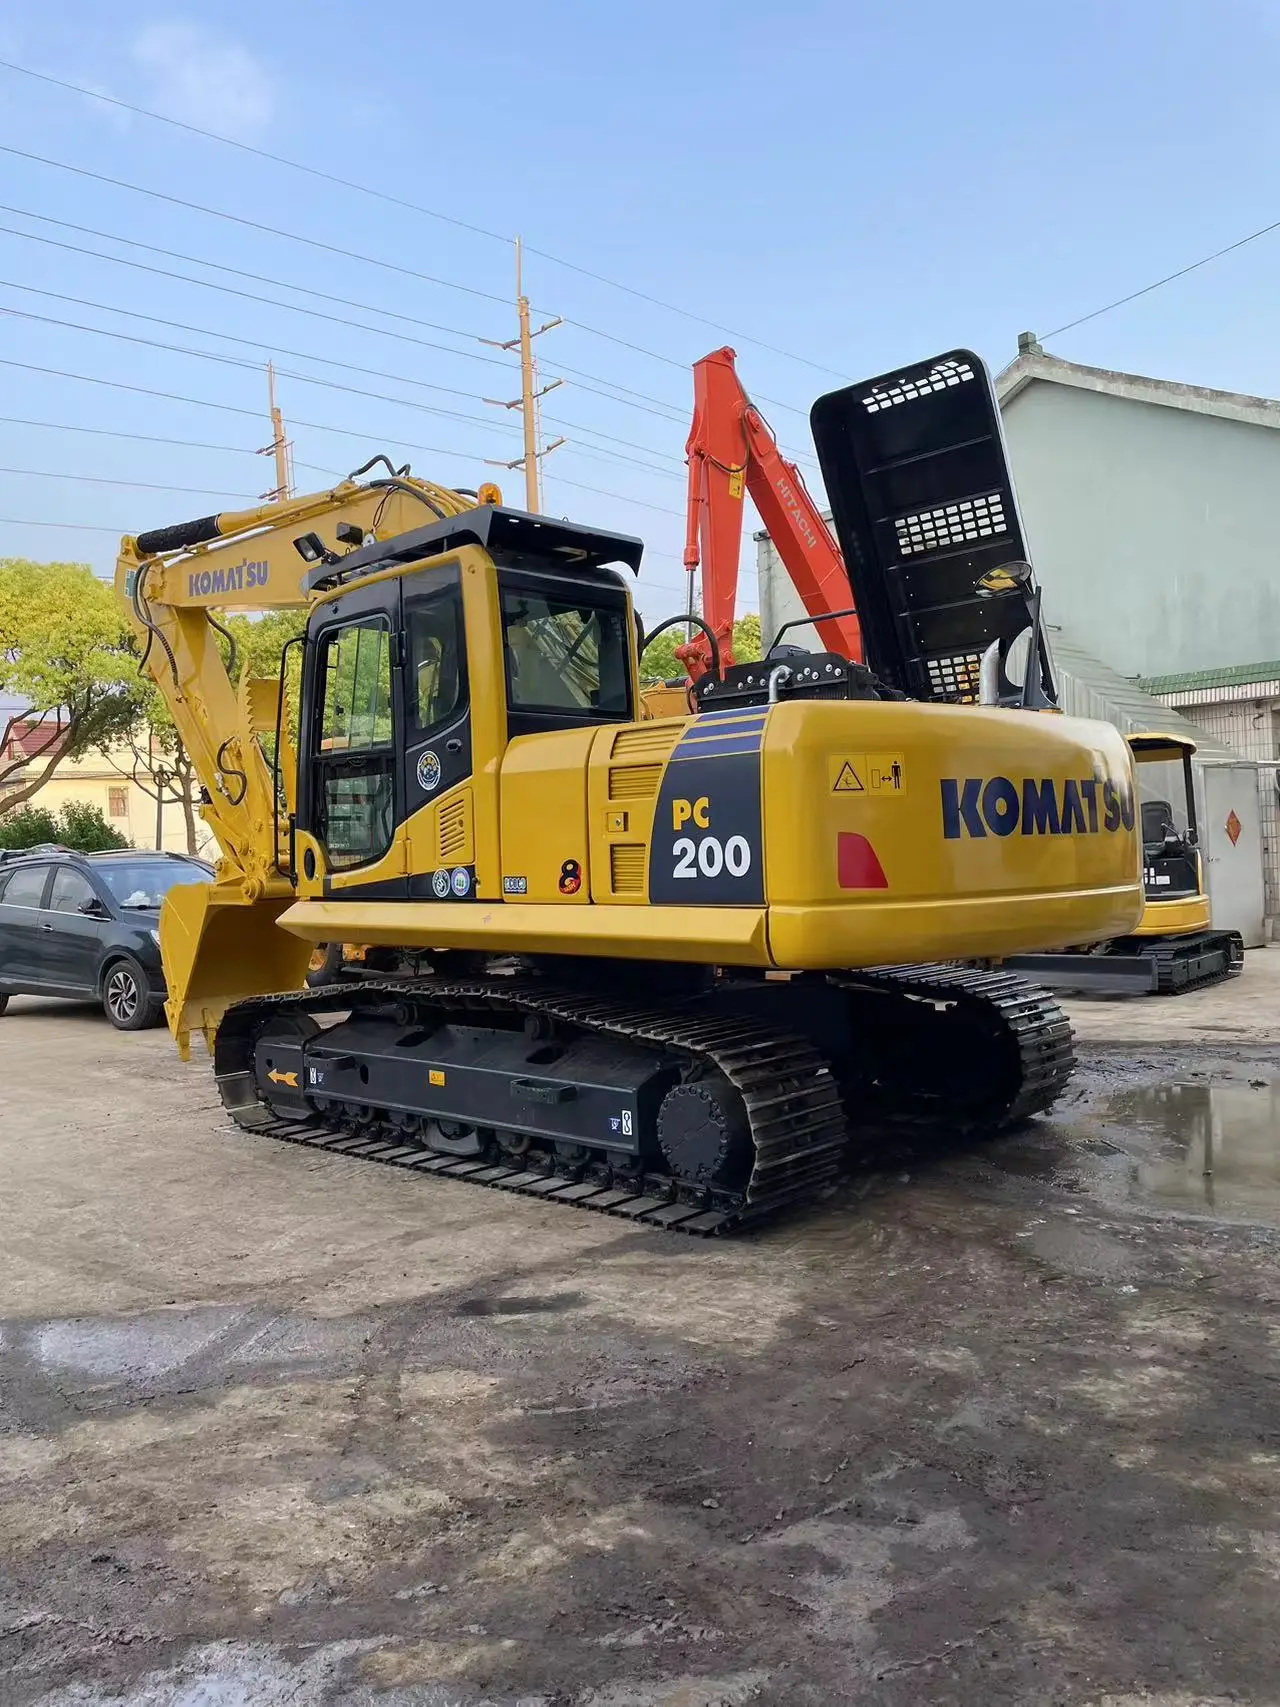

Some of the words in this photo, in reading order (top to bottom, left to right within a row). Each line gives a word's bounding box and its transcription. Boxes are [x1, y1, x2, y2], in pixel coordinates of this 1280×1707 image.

[776, 478, 817, 548] HITACHI
[188, 558, 268, 597] KOMATSU
[672, 796, 710, 831] PC
[940, 775, 1135, 839] KOMATSU
[672, 834, 751, 879] 200
